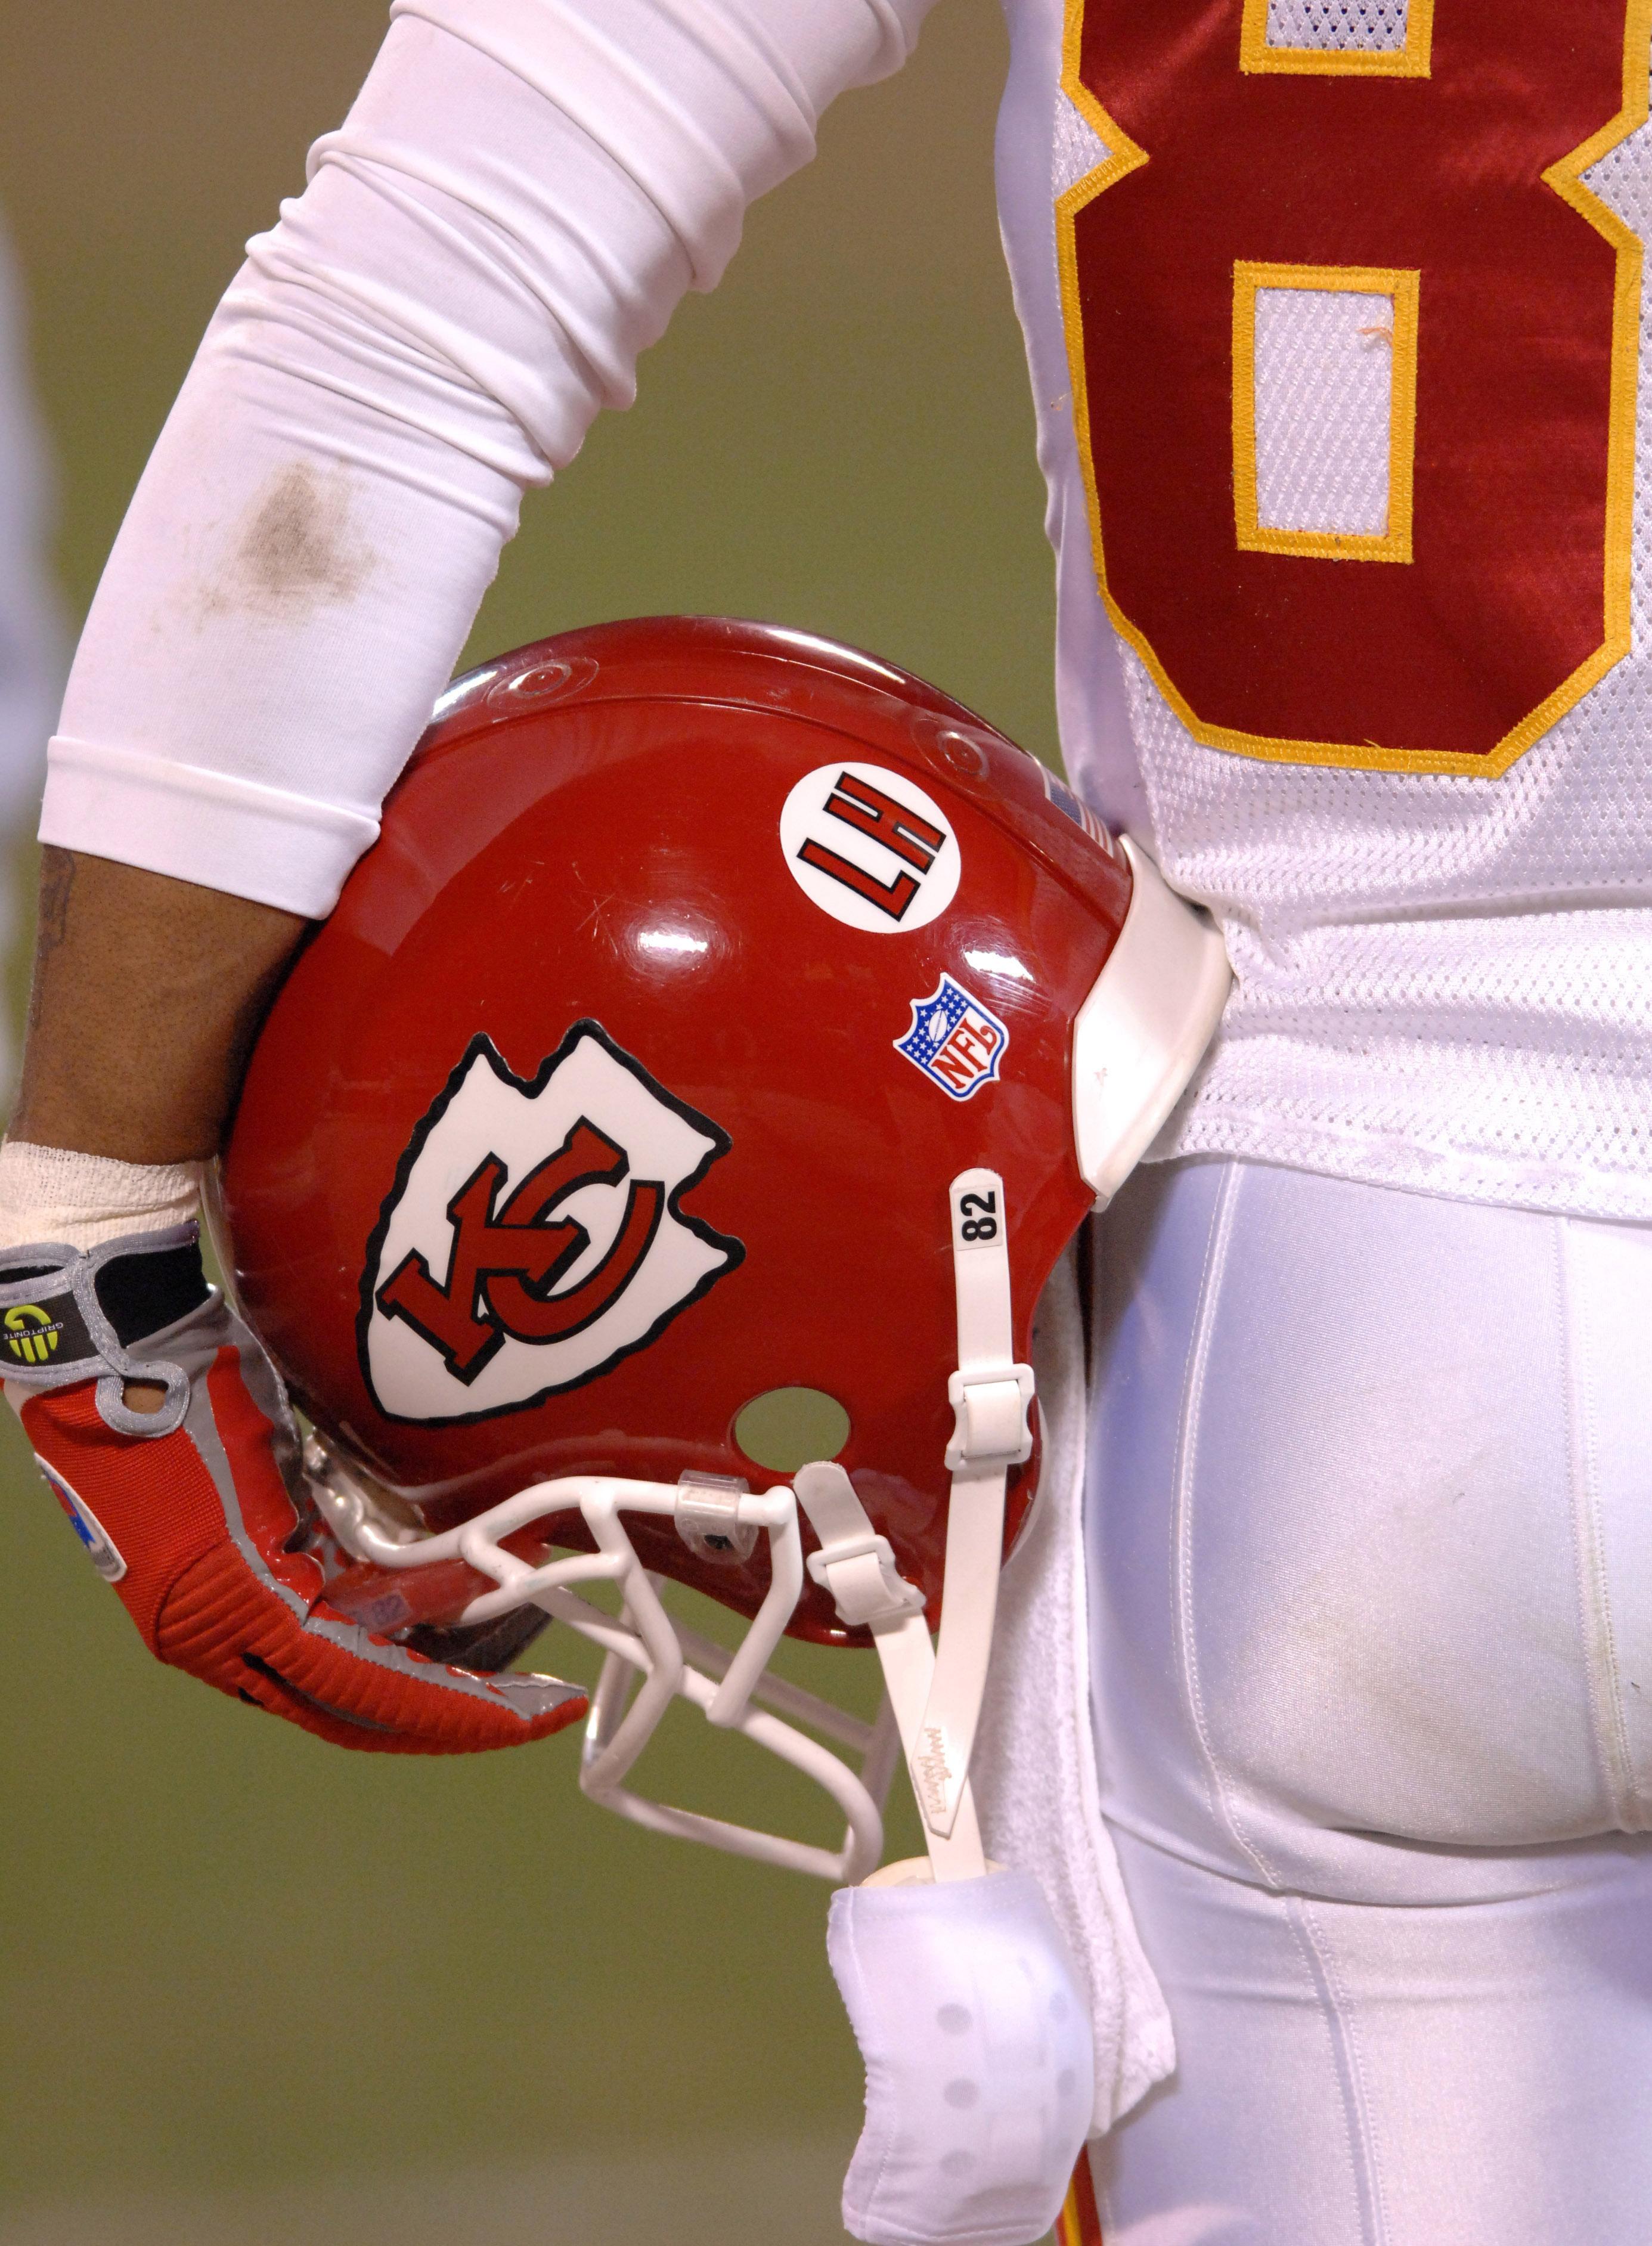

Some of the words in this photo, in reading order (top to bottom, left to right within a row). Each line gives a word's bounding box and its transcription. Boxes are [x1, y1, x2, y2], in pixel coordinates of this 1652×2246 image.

[1056, 0, 1650, 779] 8
[796, 771, 947, 922] LH
[932, 1017, 997, 1089] NFL
[375, 1115, 665, 1386] KC
[960, 1191, 996, 1241] 82
[3, 1322, 64, 1340] GRIPTONITE
